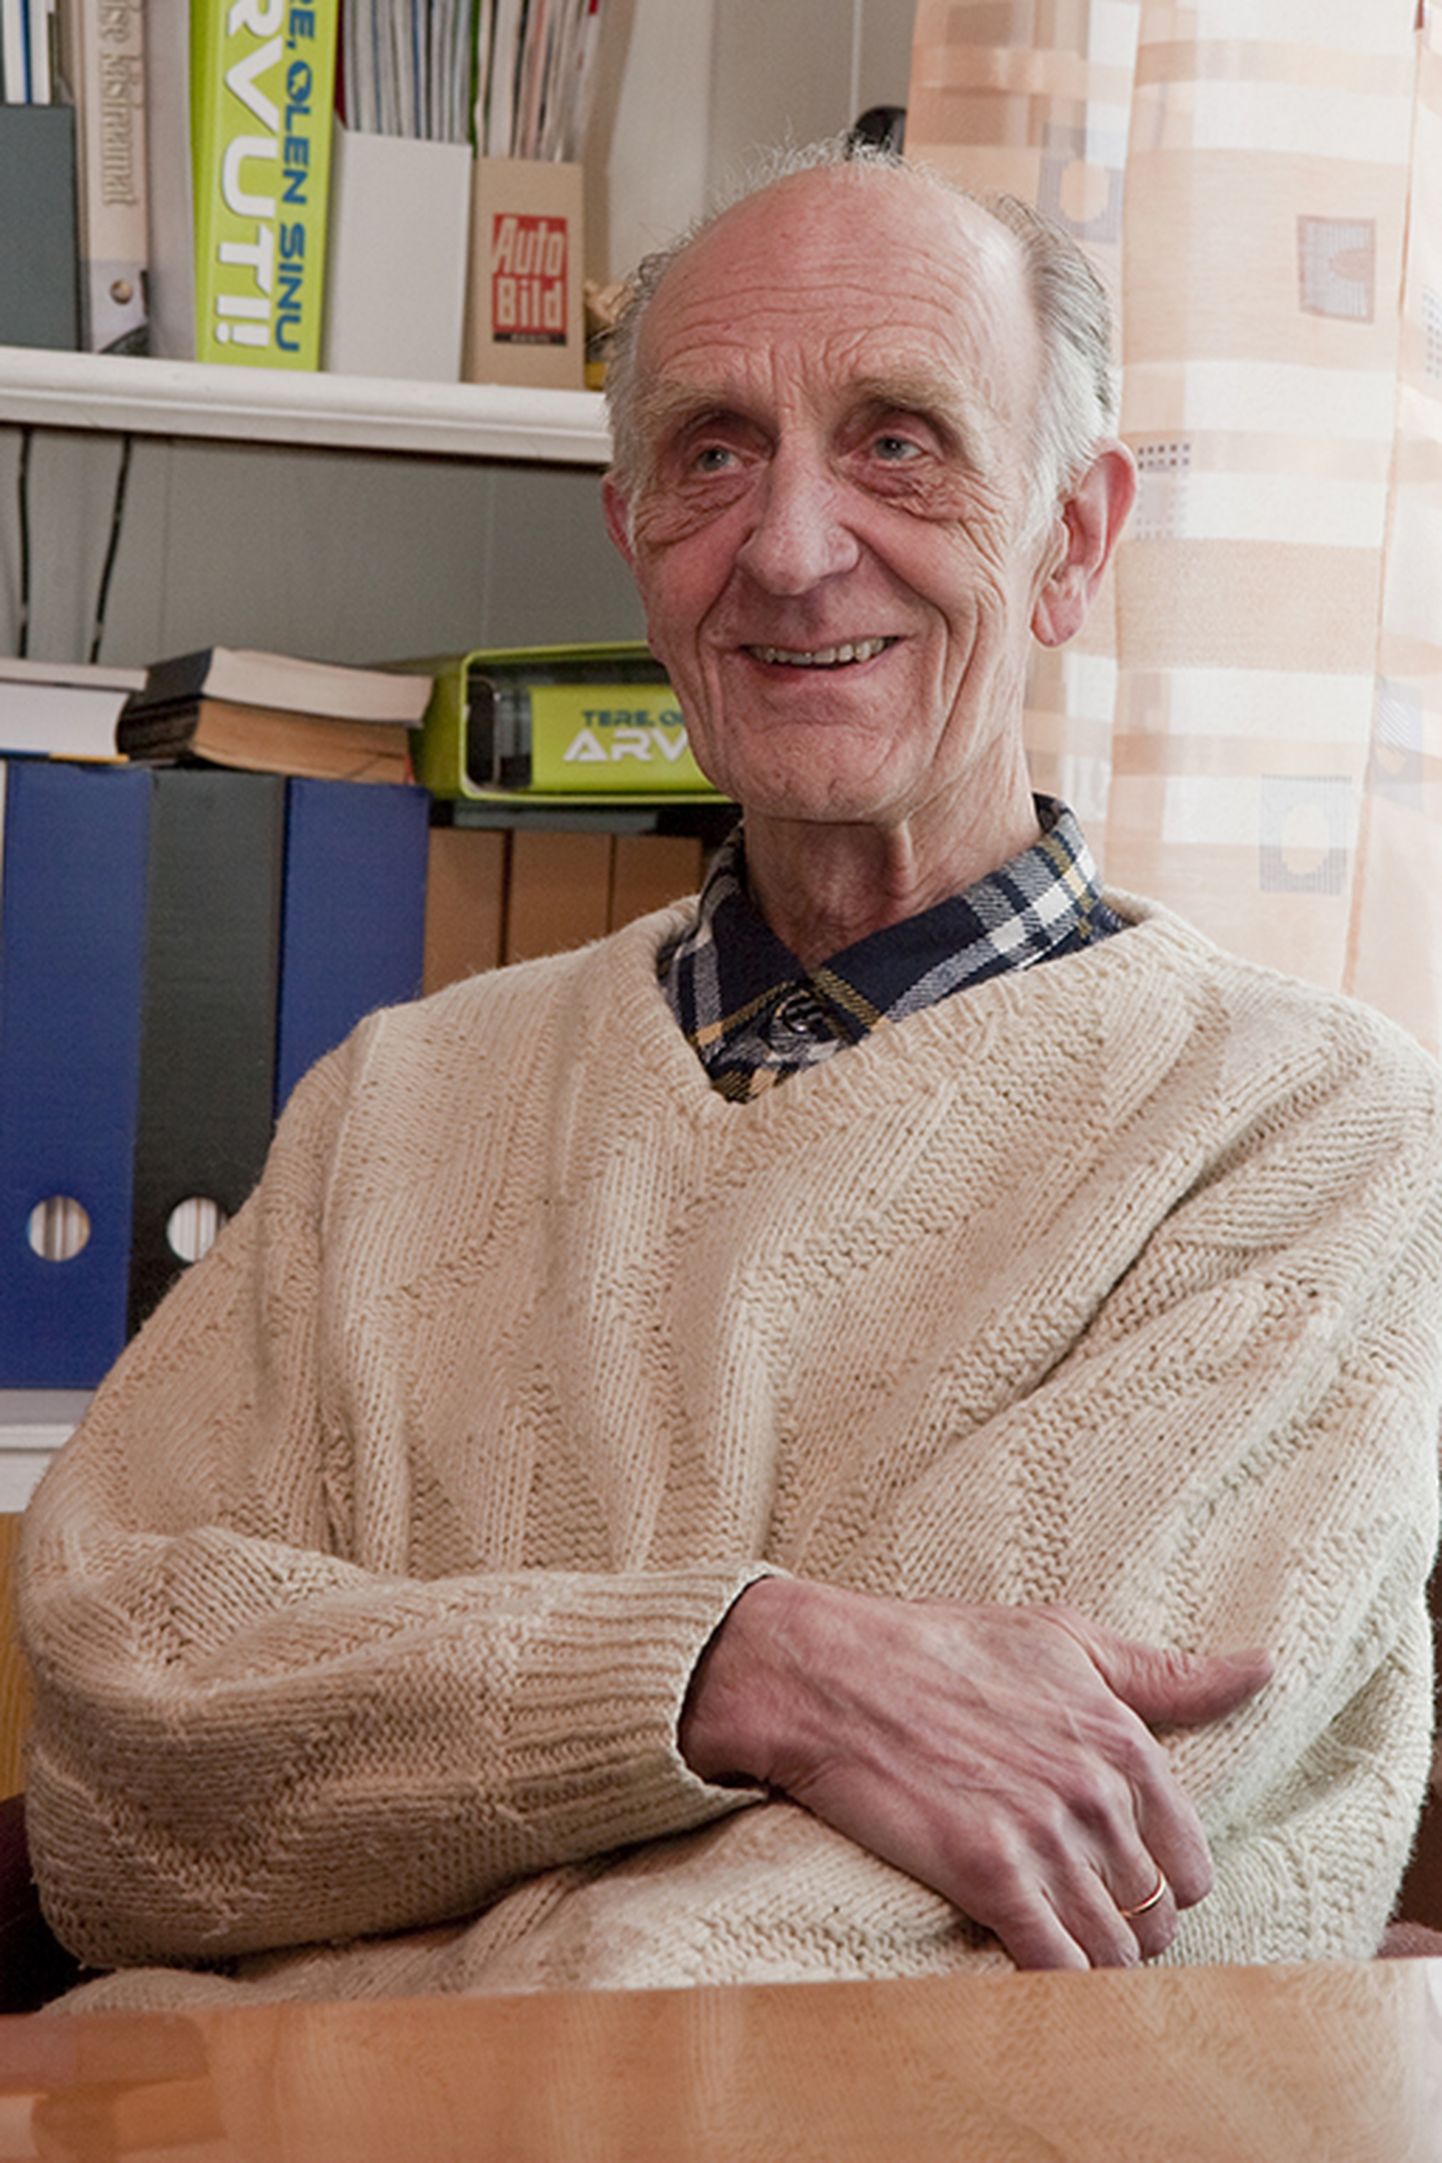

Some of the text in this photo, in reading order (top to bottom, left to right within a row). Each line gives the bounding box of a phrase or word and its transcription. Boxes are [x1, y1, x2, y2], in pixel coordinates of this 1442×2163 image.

[275, 0, 316, 352] E, OLEN SINU
[492, 217, 564, 277] Auto
[497, 277, 563, 329] Bild
[563, 728, 688, 761] ARV
